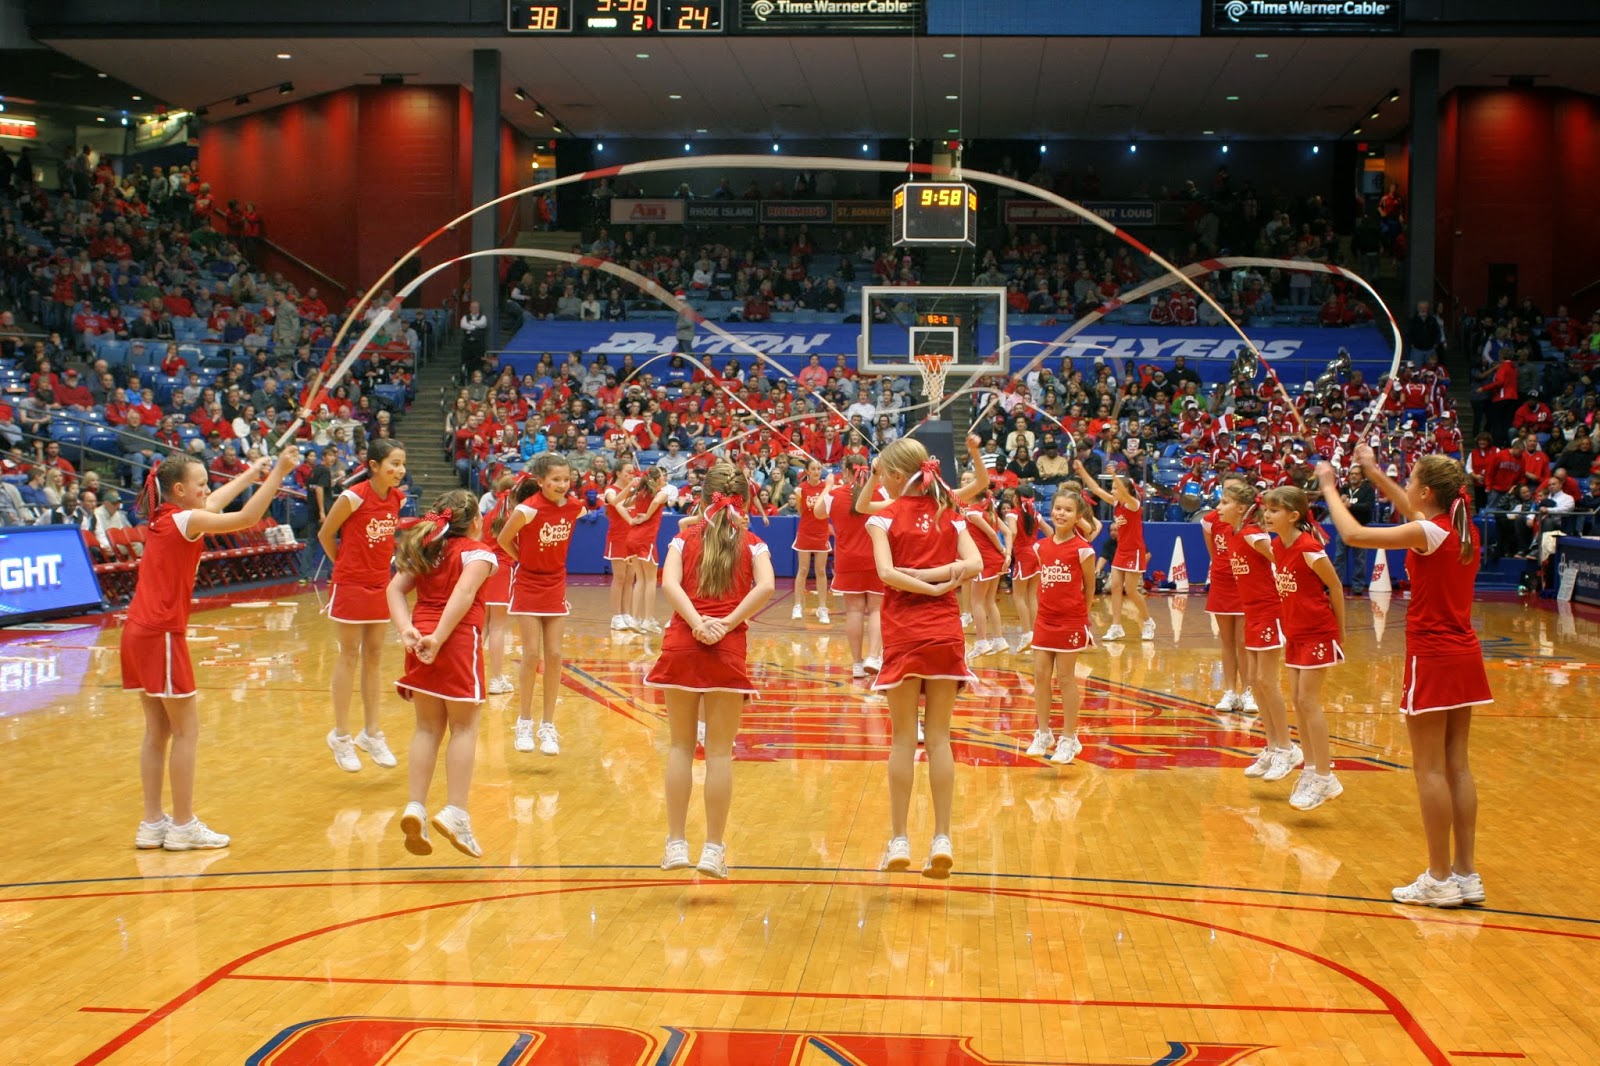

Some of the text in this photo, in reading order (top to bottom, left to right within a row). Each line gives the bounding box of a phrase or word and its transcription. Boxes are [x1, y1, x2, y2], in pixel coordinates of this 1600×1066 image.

[777, 1, 907, 13] Time Warner Cable
[1251, 1, 1386, 15] Time Warner Cable
[527, 6, 558, 30] 38
[632, 14, 644, 31] 2
[678, 6, 709, 30] 24
[921, 189, 962, 206] 9:58
[689, 207, 753, 217] RHODE ISLAND
[1088, 208, 1117, 218] AINT
[1120, 208, 1153, 218] LOUIS
[1060, 335, 1303, 359] FLYERS
